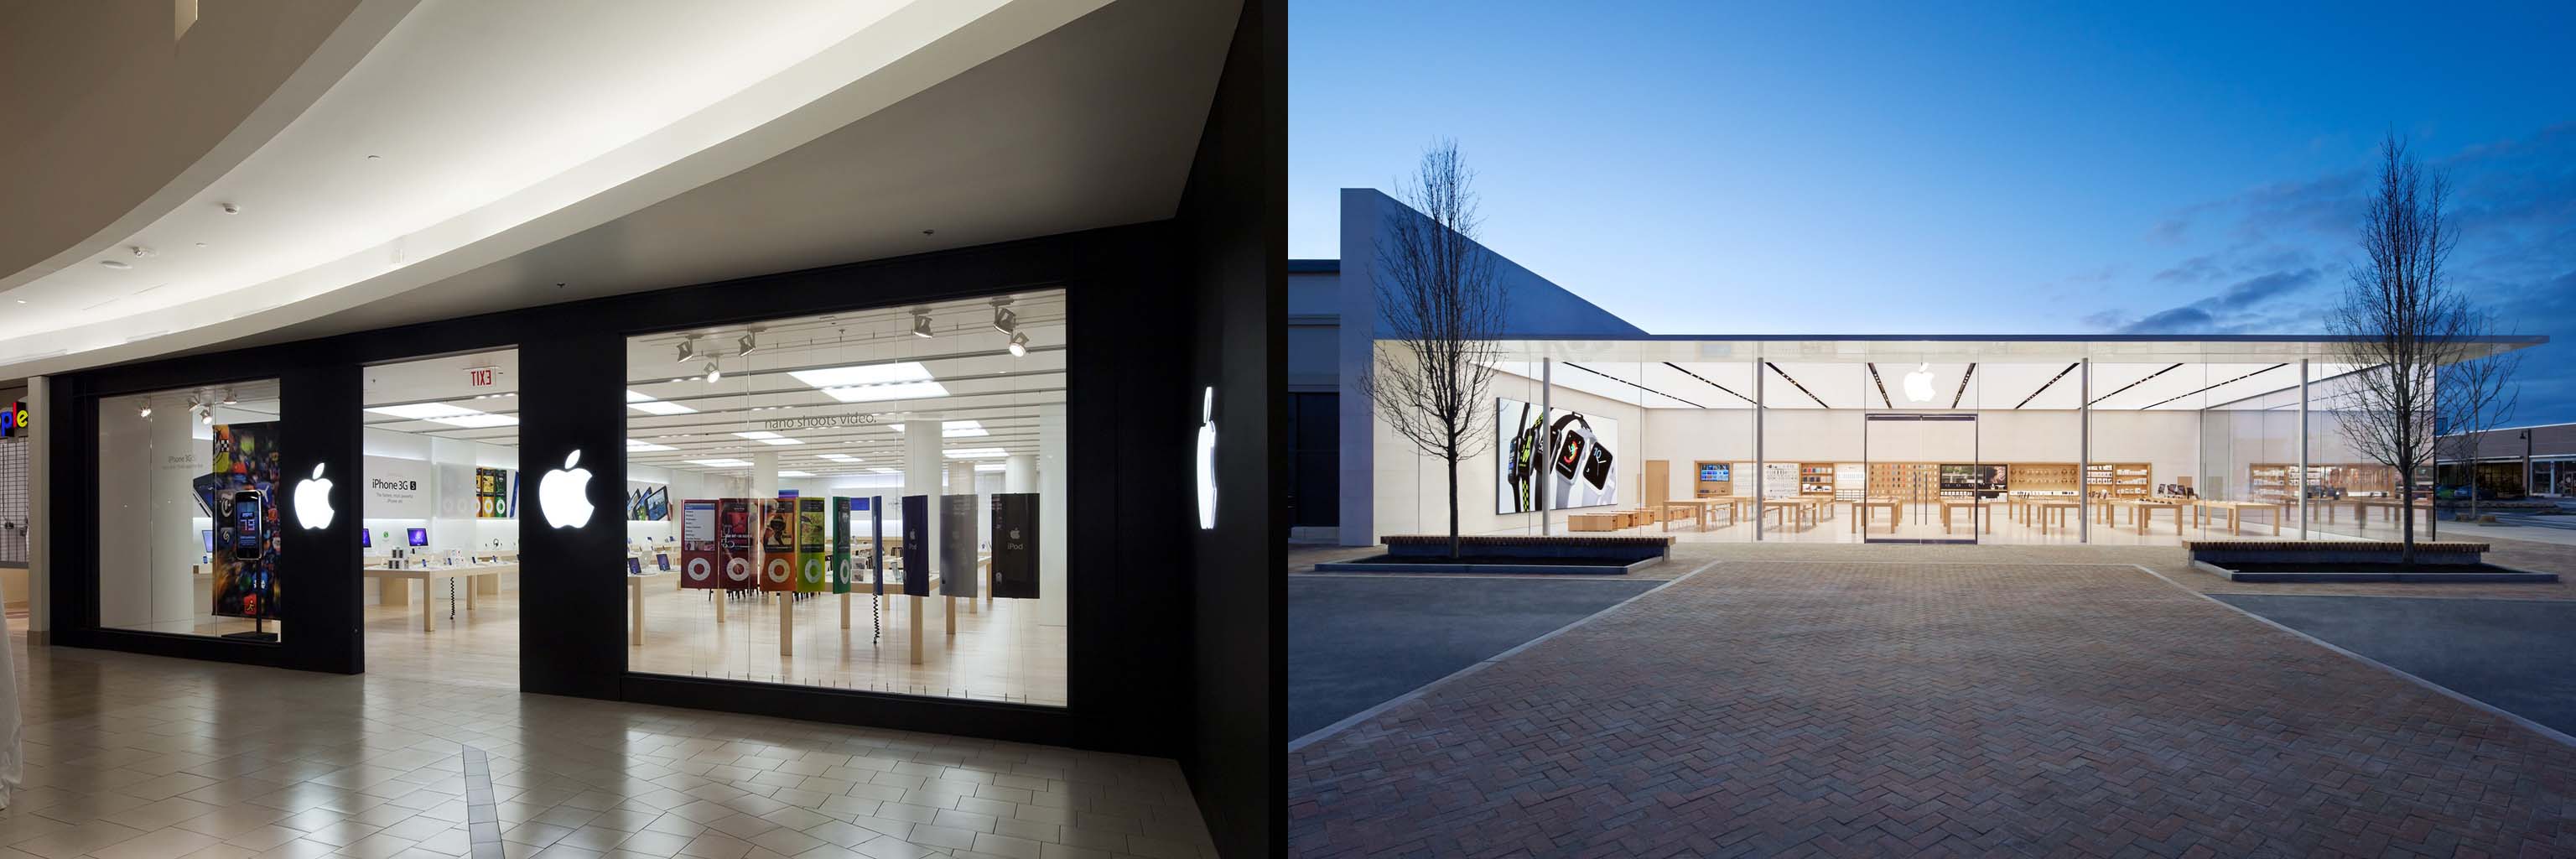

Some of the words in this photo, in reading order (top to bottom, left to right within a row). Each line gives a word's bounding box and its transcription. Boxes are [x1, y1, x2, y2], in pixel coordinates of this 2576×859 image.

[0, 402, 29, 437] ple
[765, 419, 794, 430] nano
[797, 415, 837, 427] shoots
[839, 412, 877, 424] video.
[372, 478, 397, 490] iPhone
